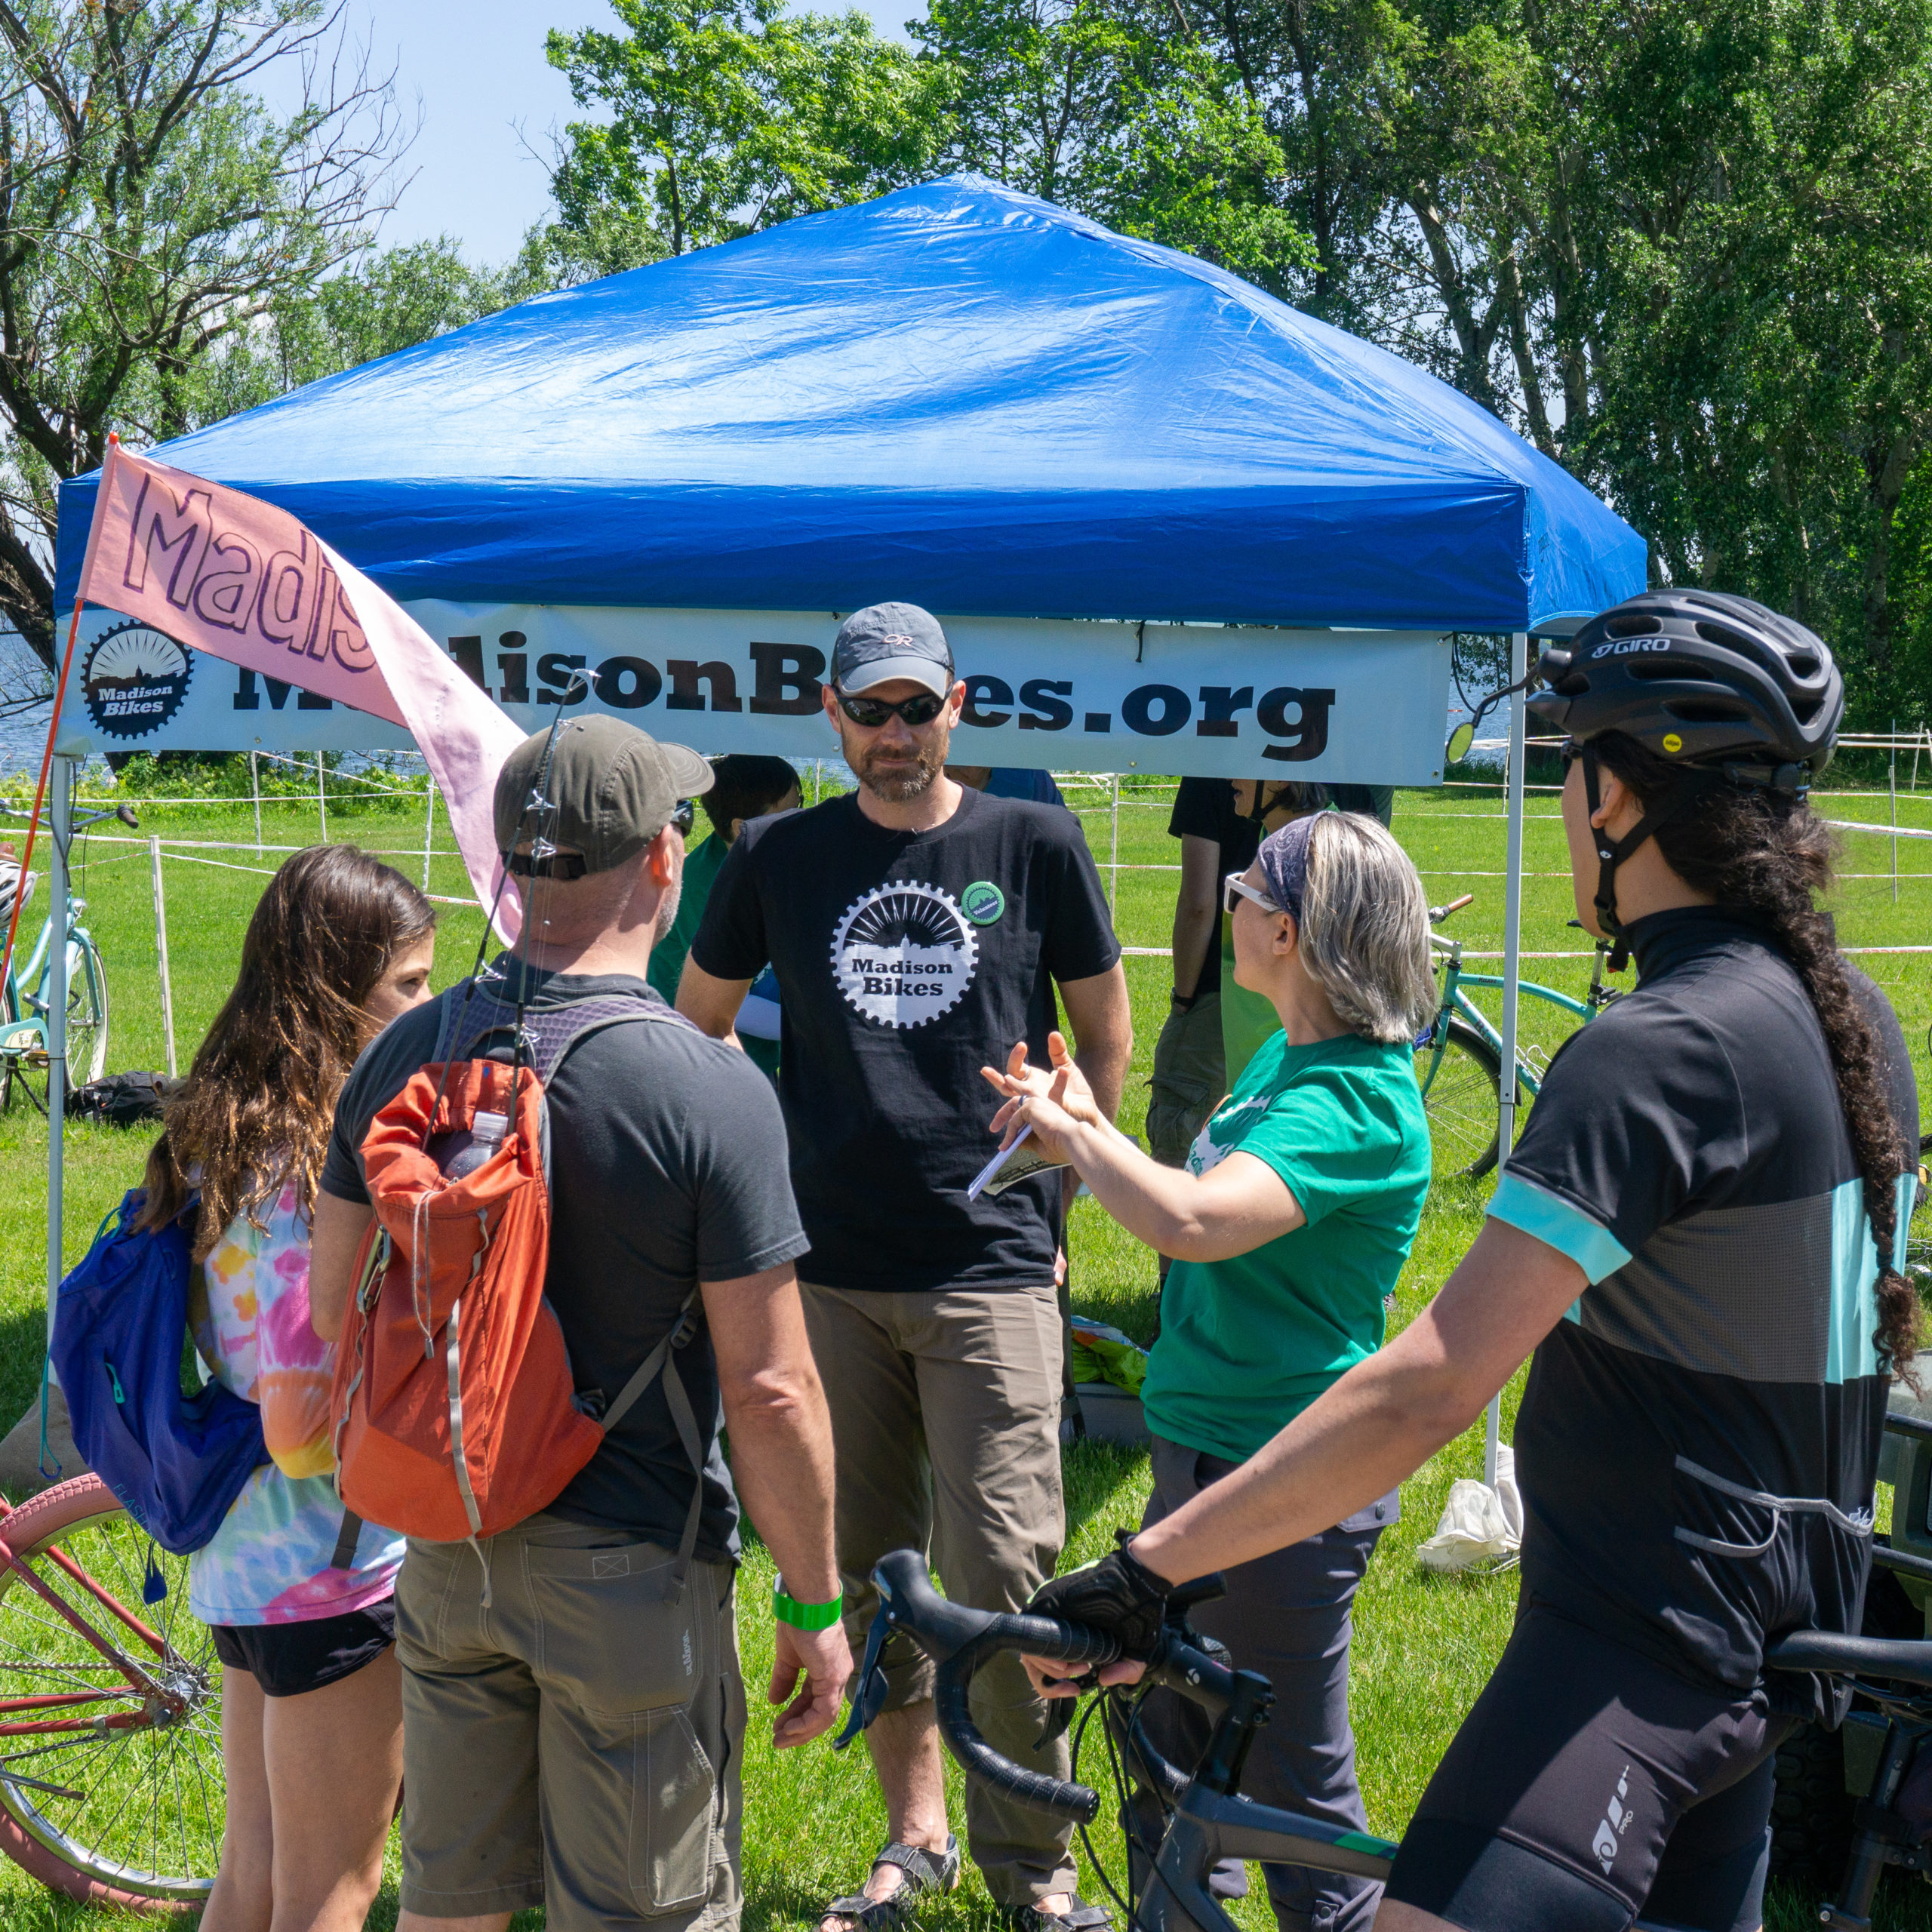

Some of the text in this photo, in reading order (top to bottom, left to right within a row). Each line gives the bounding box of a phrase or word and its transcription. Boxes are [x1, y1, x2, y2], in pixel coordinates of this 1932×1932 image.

[881, 634, 913, 647] OR
[1614, 638, 1671, 654] GIRO
[98, 686, 173, 701] Madison
[103, 700, 164, 717] Bikes
[973, 900, 998, 915] Volunteer
[852, 958, 953, 974] Madison
[863, 977, 943, 997] Bikes
[113, 1483, 149, 1525] FLASH
[1619, 1810, 1634, 1835] PRO
